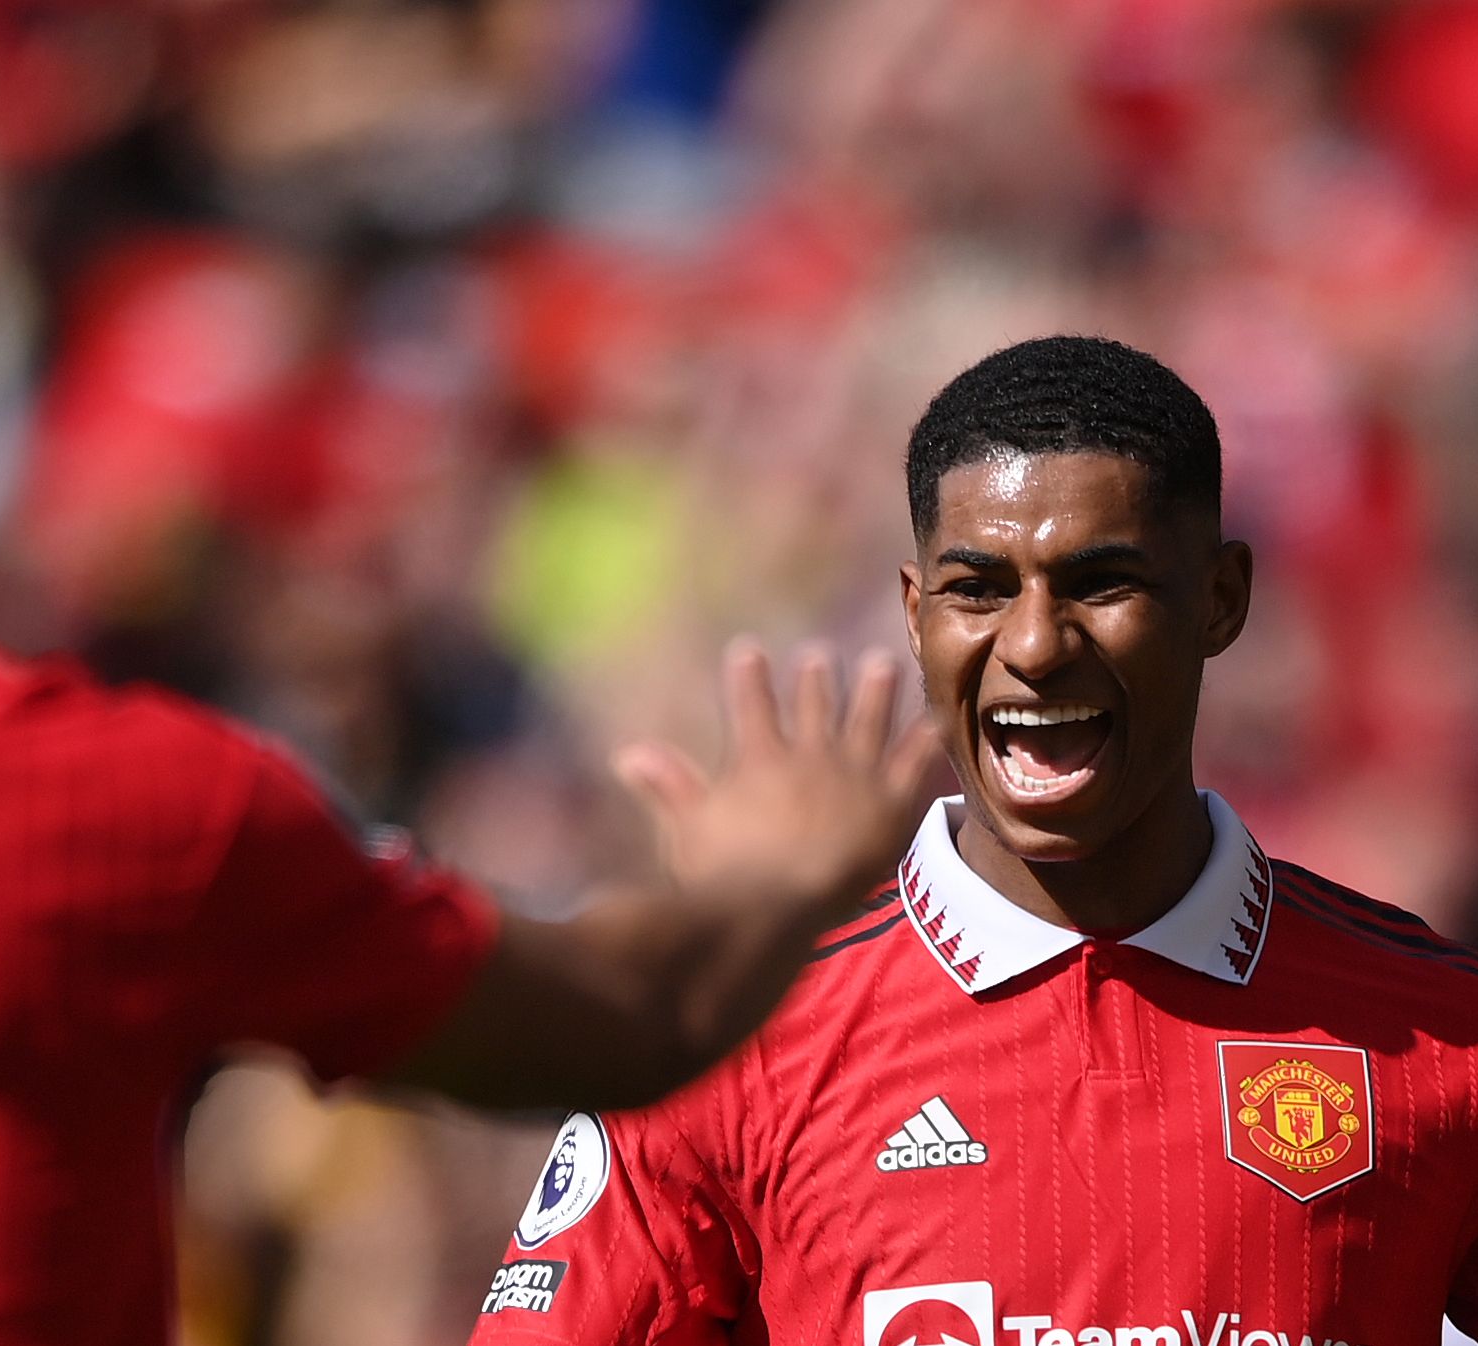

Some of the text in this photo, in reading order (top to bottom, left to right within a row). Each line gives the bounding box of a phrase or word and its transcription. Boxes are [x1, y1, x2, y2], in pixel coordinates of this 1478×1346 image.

[1248, 1067, 1346, 1106] MANCHESTER
[876, 1140, 987, 1172] adidas
[1268, 1141, 1335, 1166] UNITED
